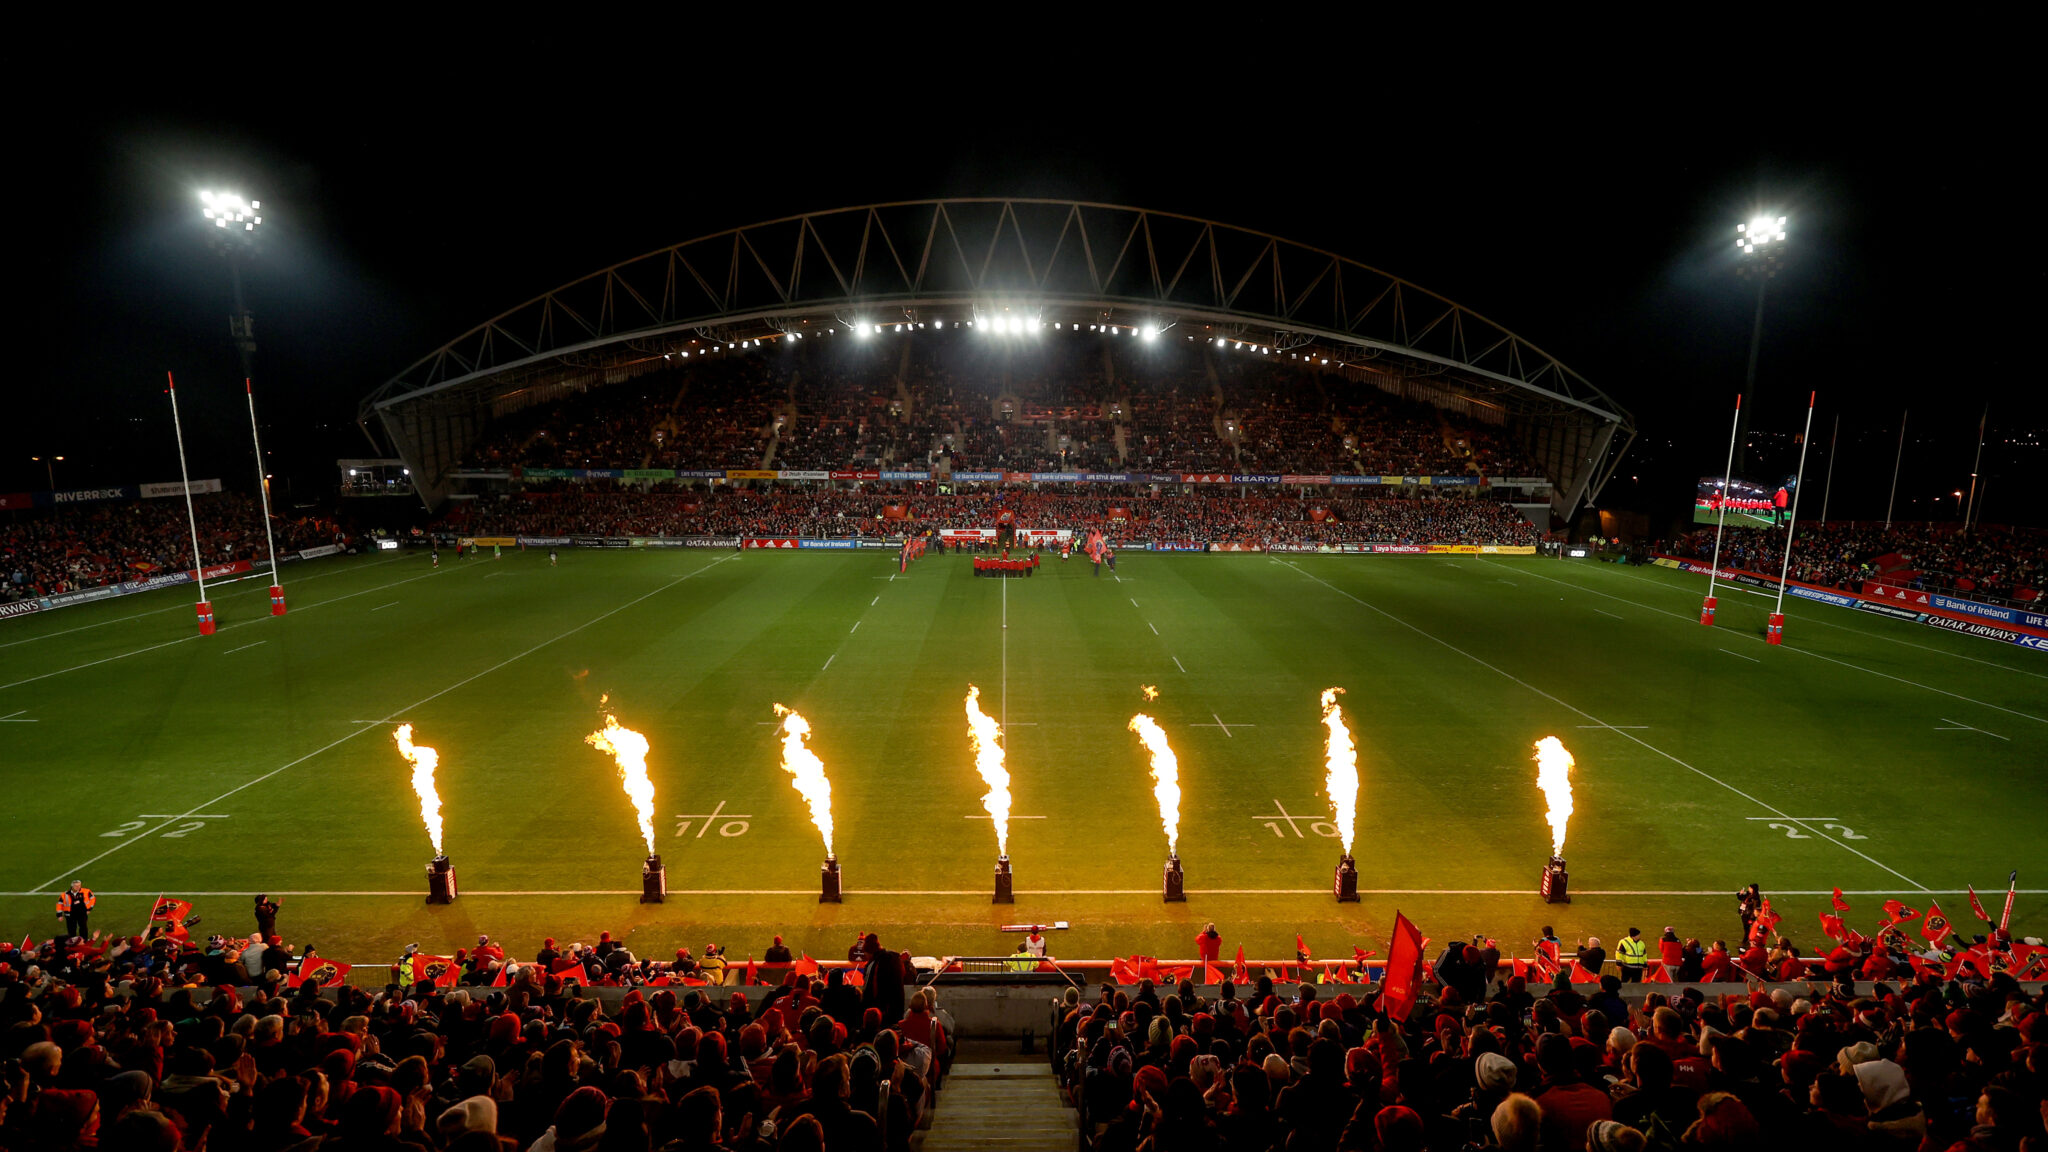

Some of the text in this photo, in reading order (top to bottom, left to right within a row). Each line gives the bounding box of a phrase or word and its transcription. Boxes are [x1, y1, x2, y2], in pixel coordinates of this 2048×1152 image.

[54, 488, 124, 503] RIVERROCK
[1688, 564, 1703, 574] laya
[1700, 567, 1736, 580] heathcare
[0, 599, 39, 616] RWAYS
[1946, 600, 2009, 620] Bank of Ireland
[2025, 615, 2043, 626] LIFE
[1928, 616, 2019, 642] QATAR AIRWAYS
